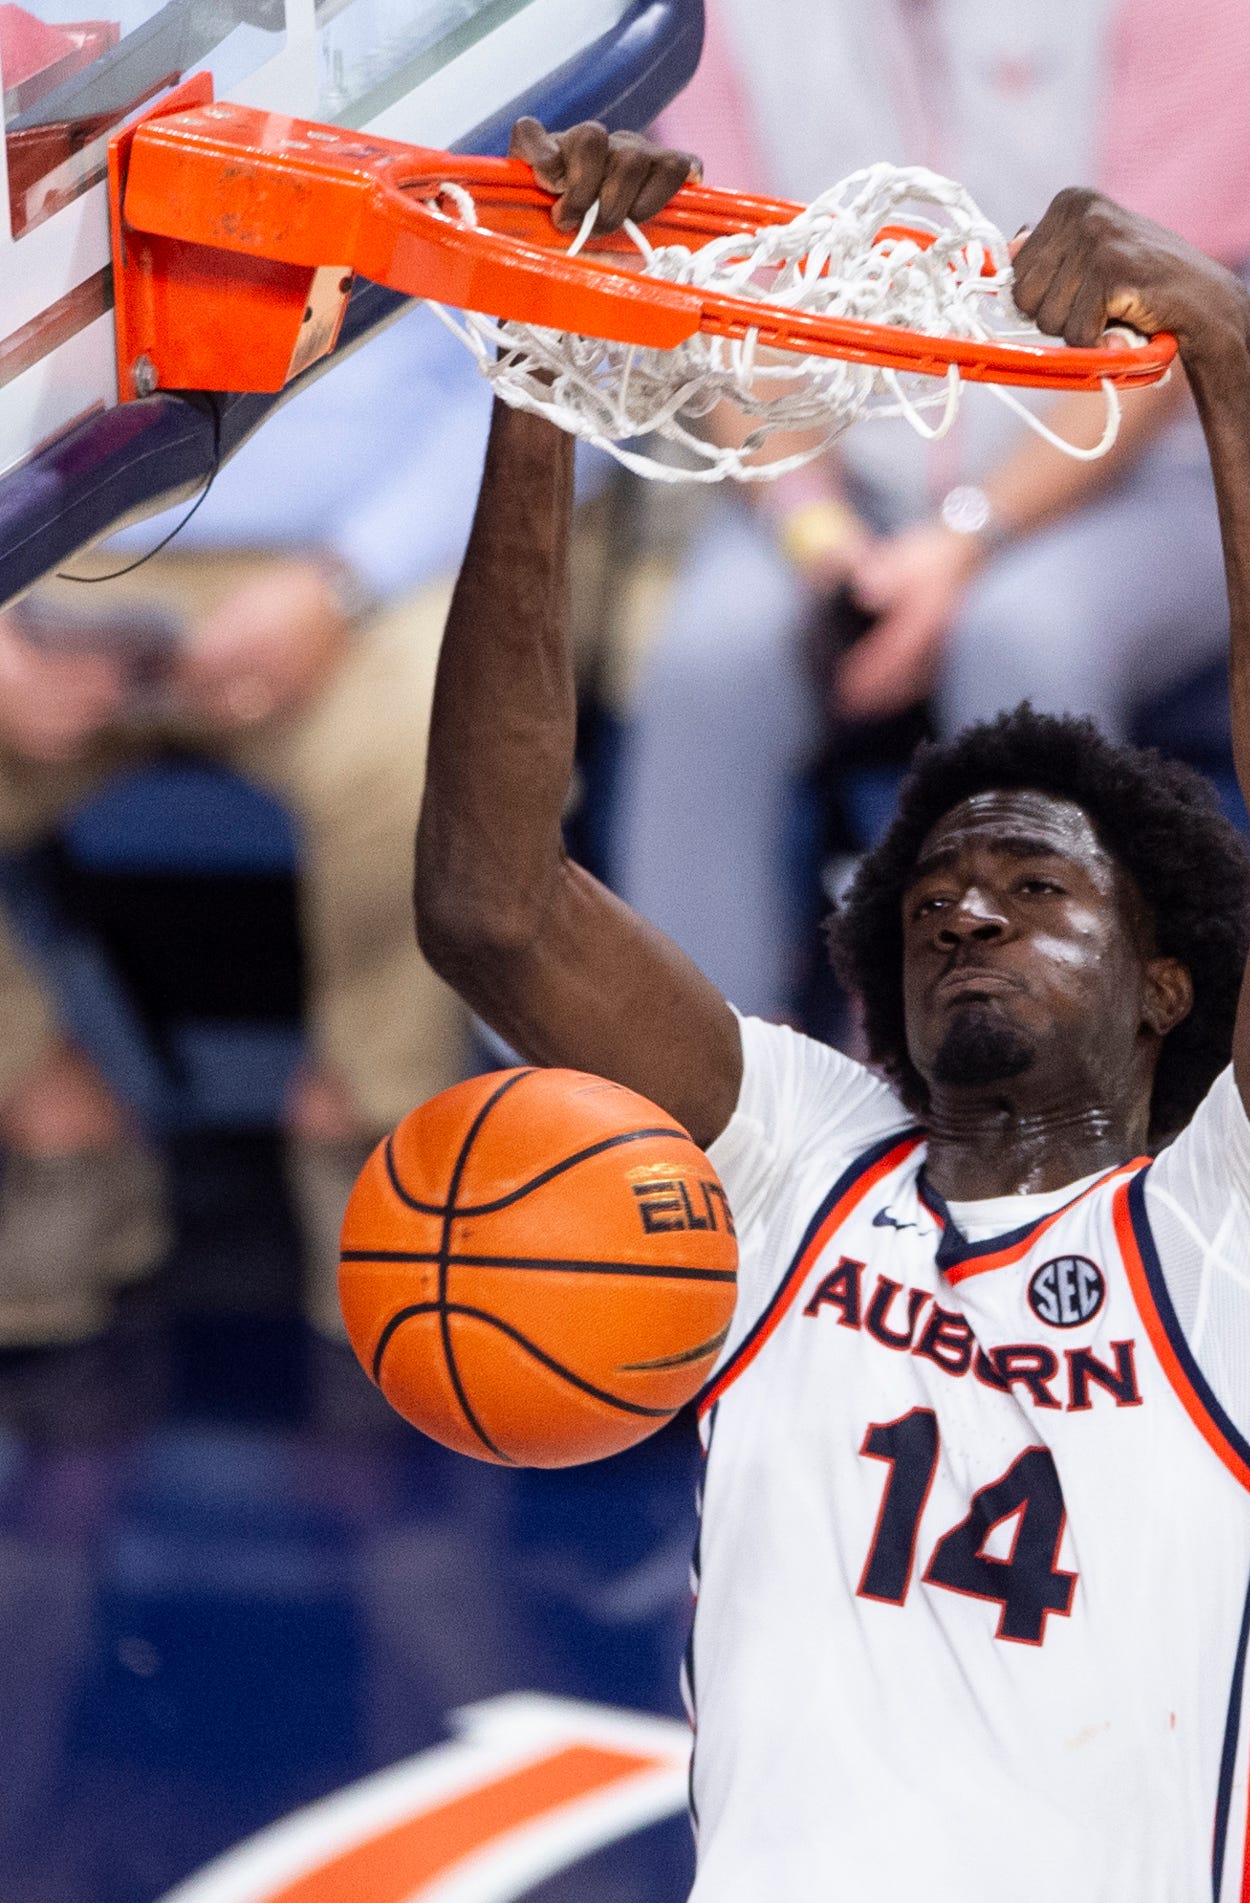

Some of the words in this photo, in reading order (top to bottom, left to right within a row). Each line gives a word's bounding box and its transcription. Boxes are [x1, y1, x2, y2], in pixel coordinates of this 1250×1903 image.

[632, 1179, 736, 1238] ELIT
[1032, 1258, 1100, 1324] SEC
[856, 1406, 1080, 1647] 14
